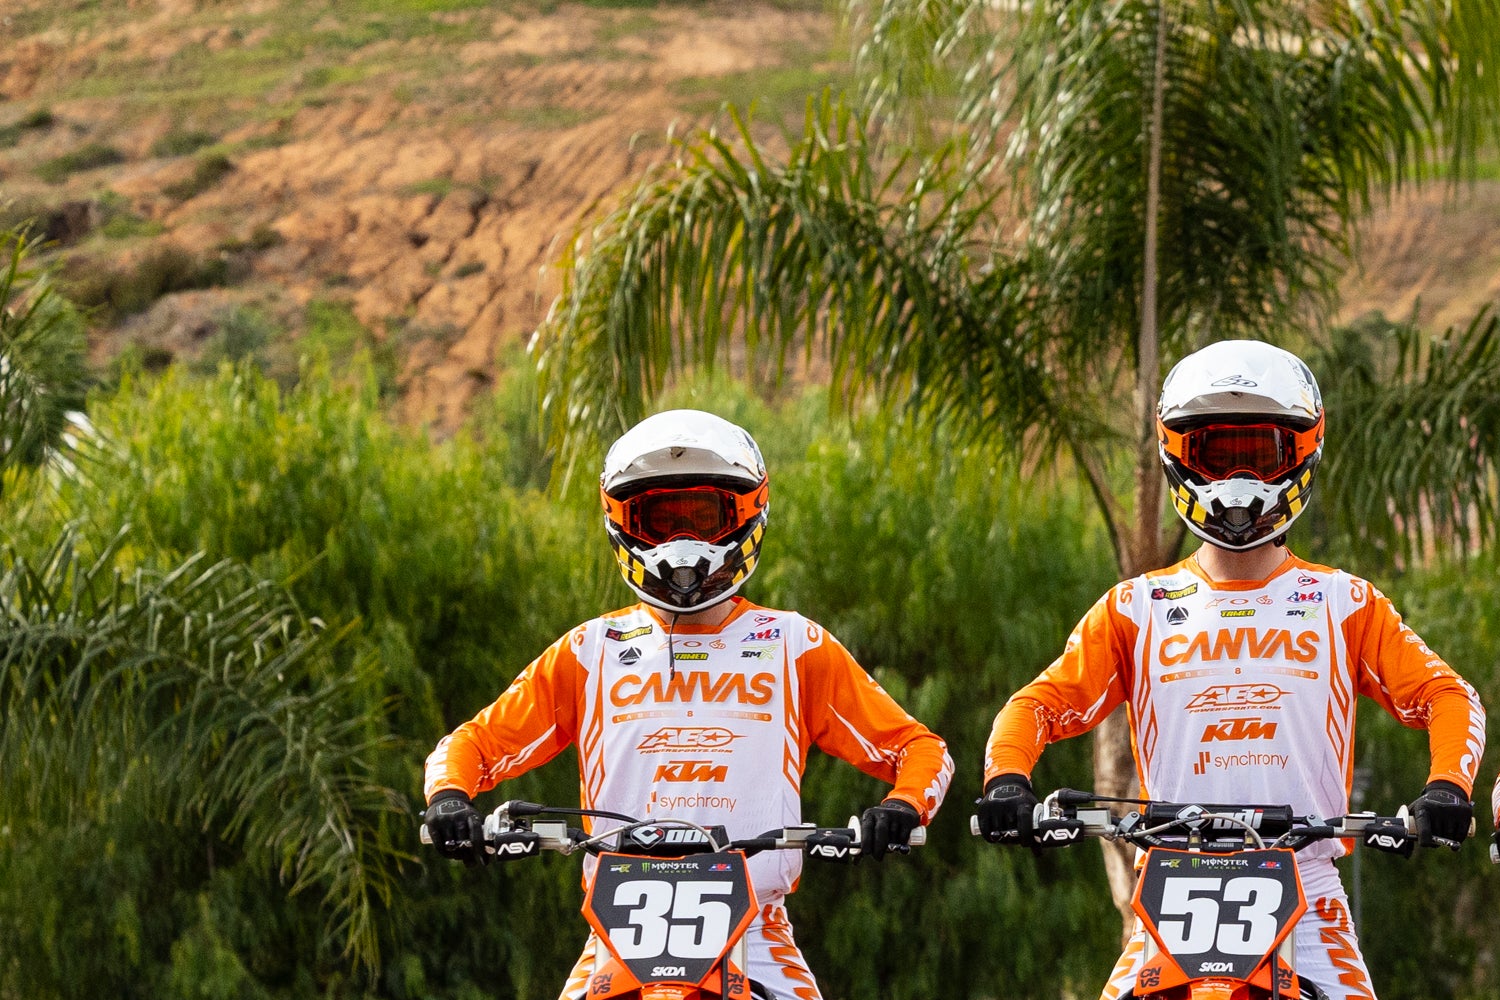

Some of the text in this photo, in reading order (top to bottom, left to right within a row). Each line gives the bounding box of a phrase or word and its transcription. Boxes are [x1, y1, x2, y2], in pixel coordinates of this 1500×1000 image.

[1158, 628, 1320, 666] CANVAS
[610, 672, 776, 707] CANVAS
[1201, 718, 1278, 742] KTM
[1215, 751, 1288, 769] synchrony
[653, 761, 729, 783] KTM
[660, 793, 737, 812] synchrony
[1042, 827, 1079, 842] ASV
[1367, 834, 1405, 848] ASV
[498, 841, 535, 855] ASV
[810, 844, 848, 858] ASV
[651, 862, 699, 870] MONSTER
[1201, 858, 1249, 866] MONSTER
[609, 880, 734, 960] 35
[1157, 877, 1283, 955] 53
[651, 966, 686, 976] SKDA
[1140, 967, 1161, 978] CN
[1199, 962, 1234, 972] SKDA
[593, 973, 612, 984] CN
[1140, 977, 1160, 988] VS
[592, 984, 611, 994] VS
